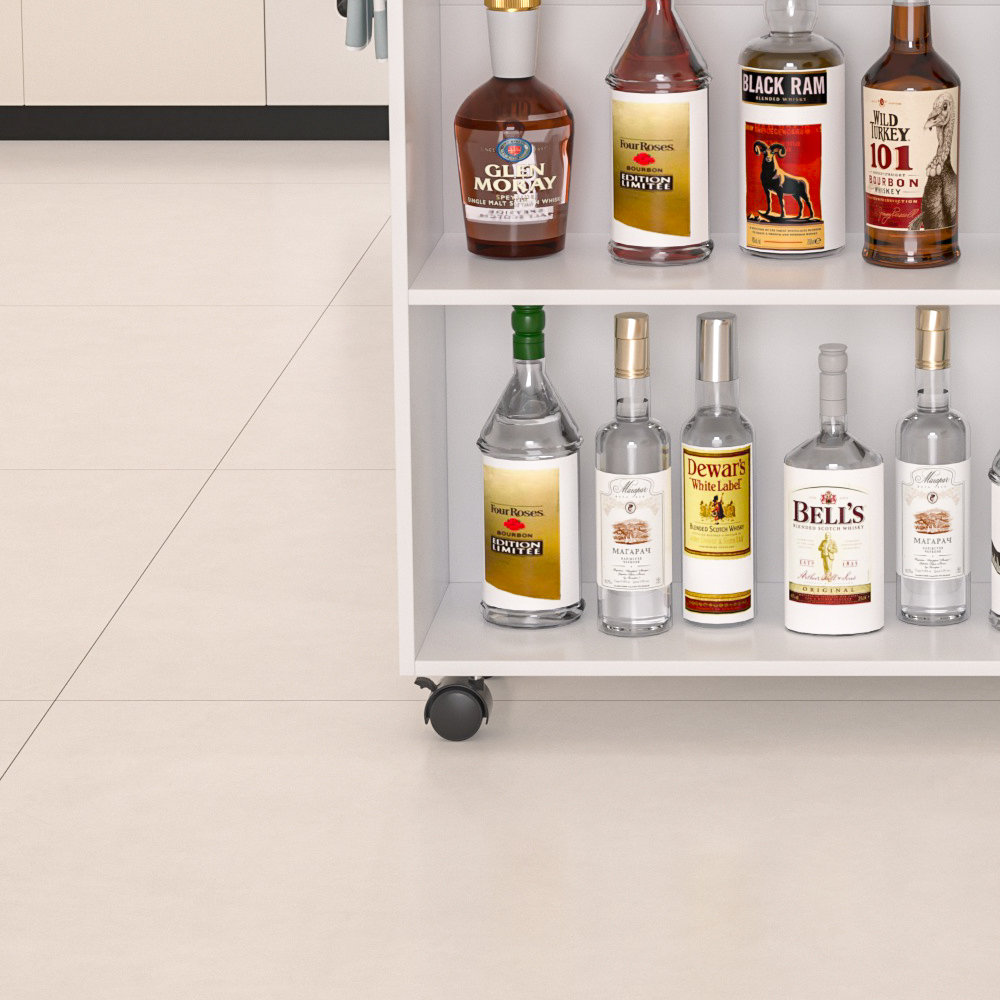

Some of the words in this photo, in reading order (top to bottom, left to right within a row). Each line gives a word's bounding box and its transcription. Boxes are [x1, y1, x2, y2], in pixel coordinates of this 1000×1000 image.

[743, 73, 785, 95] BLACK
[790, 75, 825, 95] RAM
[873, 110, 899, 127] WILD
[870, 121, 911, 142] TURKEY
[620, 139, 639, 151] Four
[640, 141, 675, 152] Roses
[870, 142, 913, 171] 101
[484, 162, 546, 178] GLEN
[626, 165, 664, 173] BOURBON
[474, 175, 557, 194] MORAY
[621, 173, 671, 184] EDITION
[868, 174, 919, 188] BOURBON
[488, 199, 506, 207] MALT
[687, 457, 746, 478] Dewar's
[490, 503, 510, 516] Four
[510, 507, 544, 517] Roses
[793, 499, 865, 525] BELL'S
[496, 530, 533, 538] BOURBON
[709, 525, 728, 533] SCOTCH
[492, 537, 541, 549] EDITION
